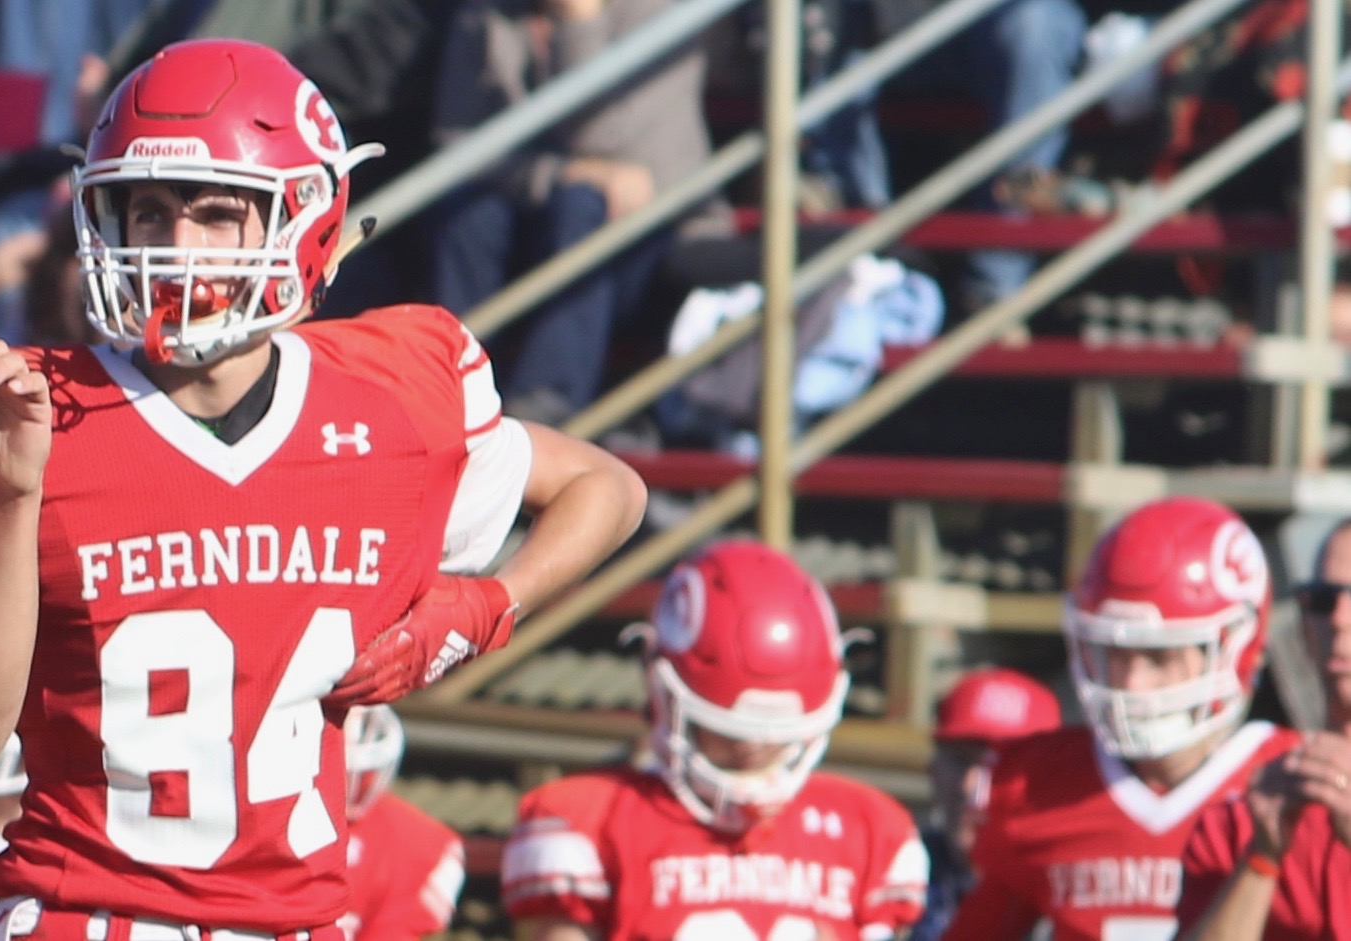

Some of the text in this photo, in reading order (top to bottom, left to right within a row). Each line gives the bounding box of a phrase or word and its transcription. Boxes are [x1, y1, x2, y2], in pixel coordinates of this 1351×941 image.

[132, 142, 197, 157] Riddell
[77, 524, 386, 600] FERNDALE
[100, 606, 356, 870] 84
[651, 853, 855, 920] FERNDALE
